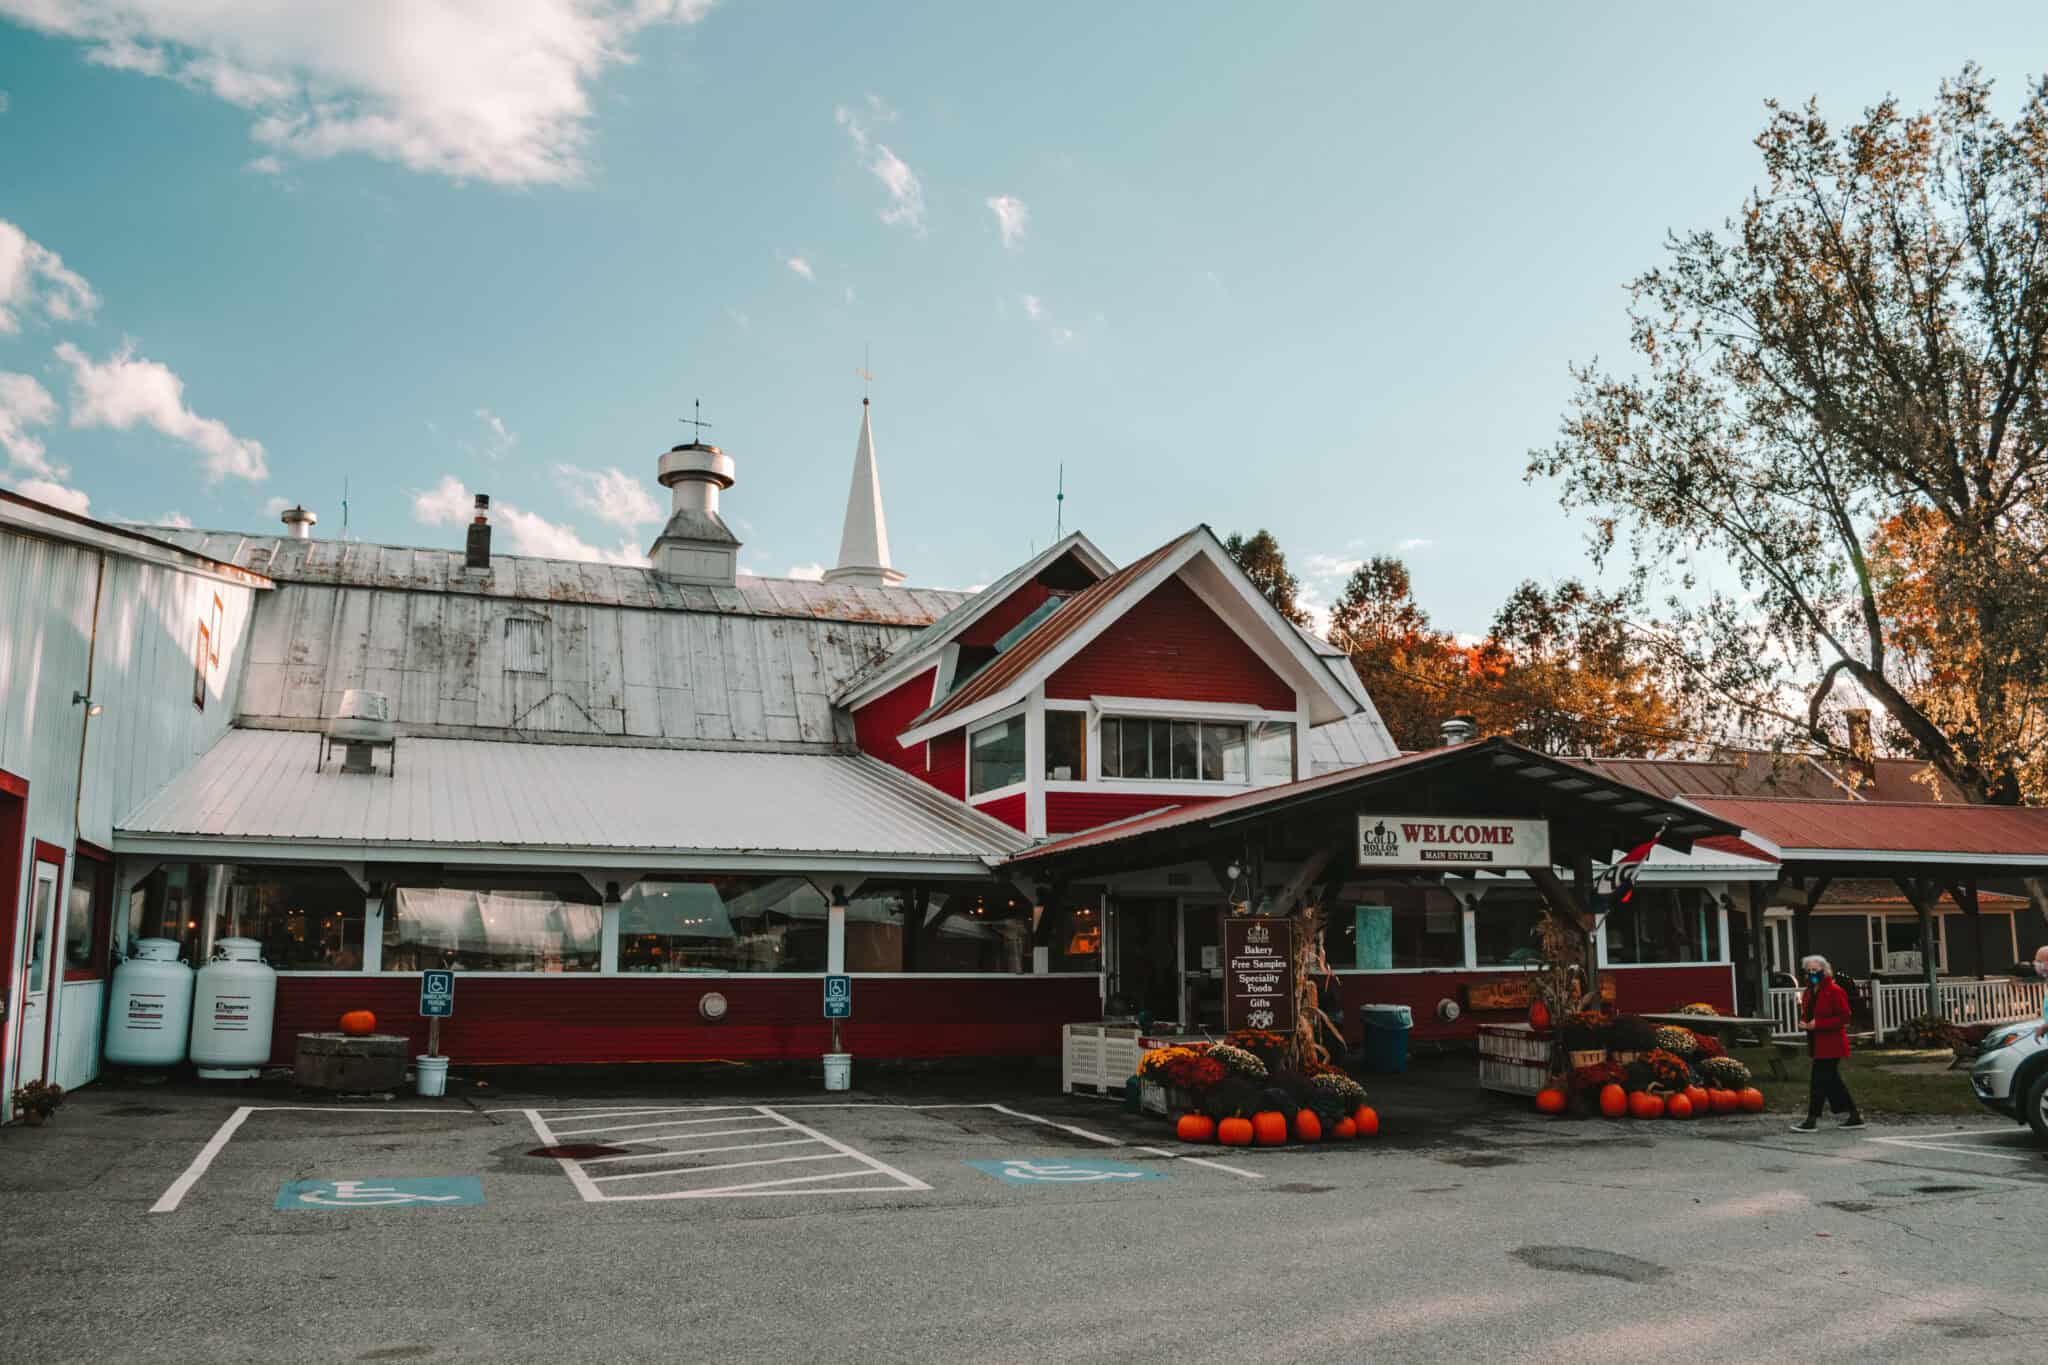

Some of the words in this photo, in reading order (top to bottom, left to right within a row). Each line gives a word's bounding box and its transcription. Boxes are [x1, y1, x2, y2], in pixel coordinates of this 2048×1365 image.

[1364, 830, 1397, 845] COLD
[1401, 823, 1514, 845] WELCOME
[1363, 843, 1399, 852] HOLLOW
[1424, 851, 1446, 859] MAIN
[1447, 851, 1489, 860] ENTRANCE
[1244, 945, 1273, 955] Bakery
[1231, 959, 1250, 969] Free
[1253, 959, 1287, 969] Samples
[1247, 983, 1273, 993] Foods
[1249, 998, 1271, 1008] Gifts
